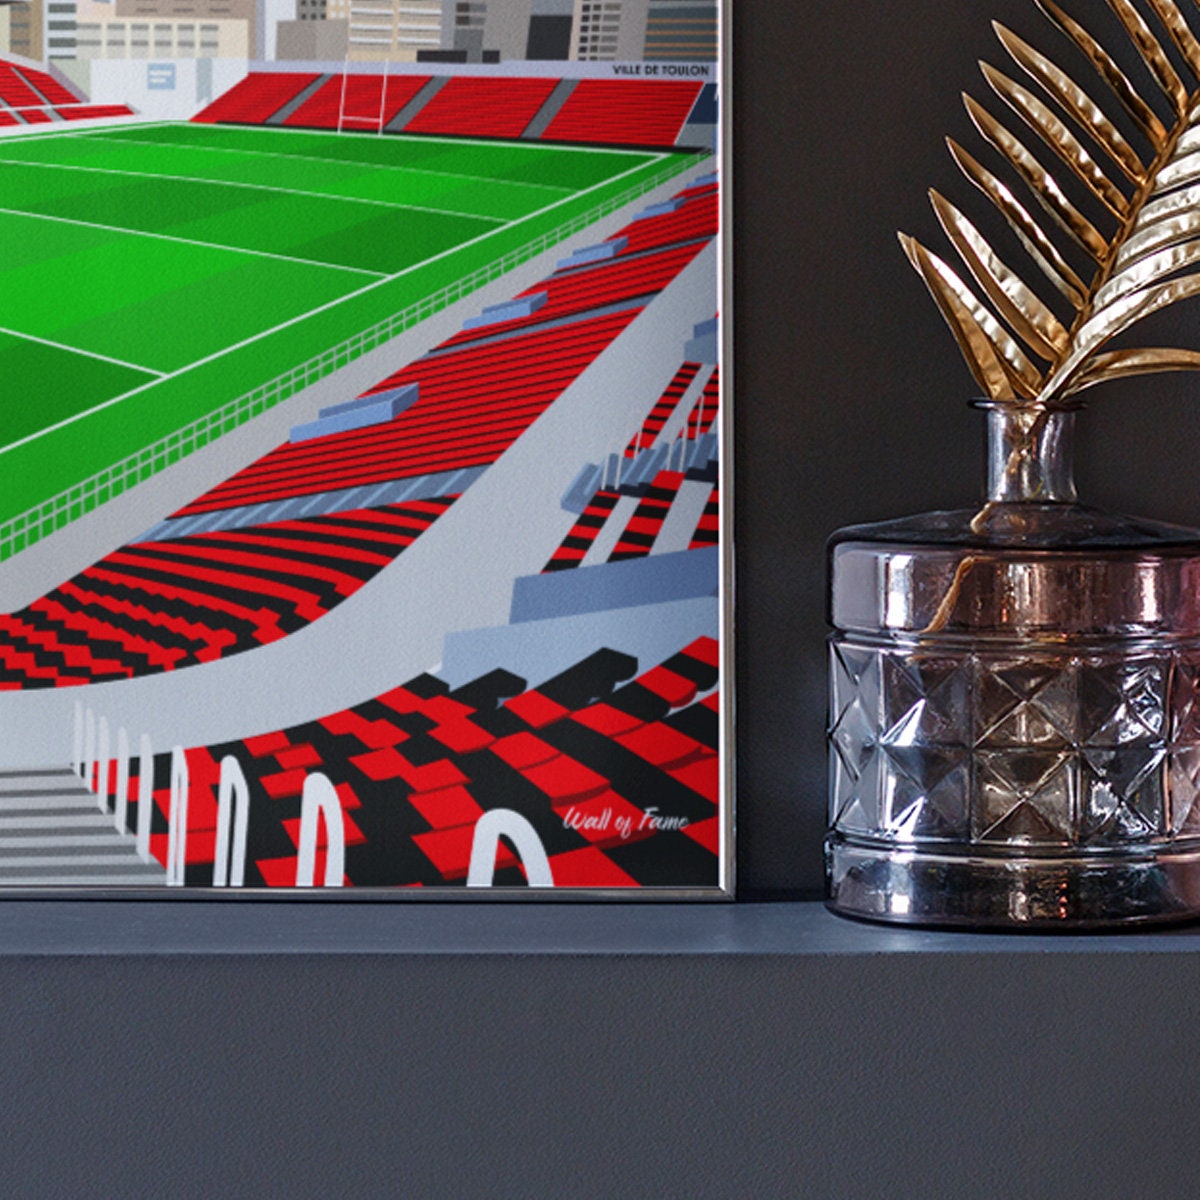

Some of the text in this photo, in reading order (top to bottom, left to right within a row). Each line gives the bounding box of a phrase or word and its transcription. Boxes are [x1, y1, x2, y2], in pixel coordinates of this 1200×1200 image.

[612, 64, 709, 76] VILLE DE TOULON
[563, 806, 689, 840] Wall of Fame
